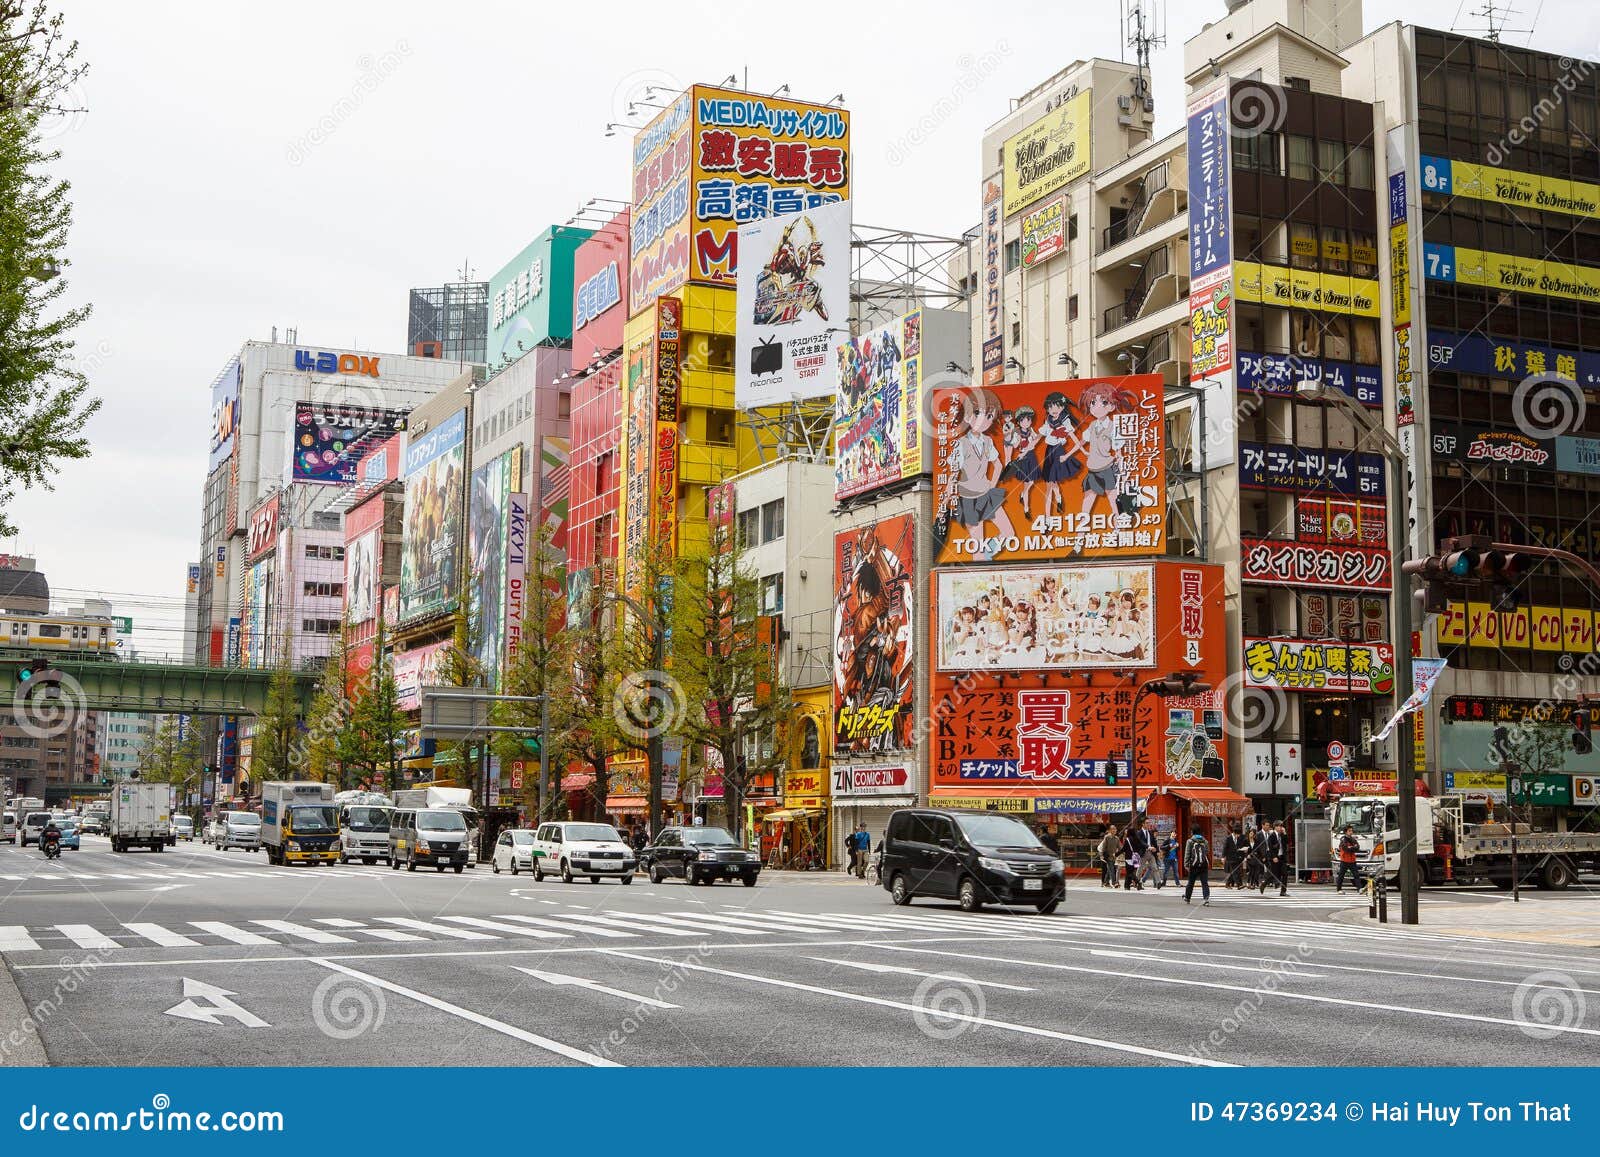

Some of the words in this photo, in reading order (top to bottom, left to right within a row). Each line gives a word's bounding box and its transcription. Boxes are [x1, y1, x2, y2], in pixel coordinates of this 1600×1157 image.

[698, 98, 846, 138] MEDIAリサイクル
[698, 129, 844, 185] 激安販売
[1015, 136, 1048, 172] Yellow
[1018, 142, 1076, 190] Submarine
[1200, 110, 1217, 267] アメニティードリーム
[1424, 164, 1448, 190] 8F
[1495, 182, 1533, 203] Yellow
[1535, 190, 1596, 214] Submarine
[1328, 245, 1341, 256] 7F
[1426, 253, 1451, 278] 7F
[575, 260, 622, 332] SEGA
[1274, 281, 1312, 302] Yellow
[1313, 286, 1373, 310] Submarine
[1499, 269, 1538, 290] Yellow
[1539, 275, 1600, 298] Submarine
[1192, 307, 1228, 338] まんが
[660, 342, 677, 350] DVD
[790, 342, 829, 357] 公式生放送
[1192, 336, 1215, 358] 喫茶
[1430, 345, 1453, 364] 5F
[799, 368, 820, 379] START
[1493, 345, 1578, 381] 秋葉館
[750, 376, 783, 388] niconico
[1357, 387, 1376, 401] 6F
[312, 413, 387, 429] ラブメルシー
[1139, 389, 1161, 480] とある科学の
[1112, 413, 1140, 496] 超電磁砲
[1433, 434, 1457, 454] 5F
[1243, 448, 1347, 479] アメニティードリーム
[1360, 477, 1378, 492] 5F
[511, 501, 525, 555] AKKY
[952, 535, 1020, 556] TOKYO
[1023, 532, 1055, 553] MX
[1055, 528, 1161, 550] 他にて放送開始!
[1300, 523, 1323, 534] Stars
[1246, 545, 1386, 584] メイドカジノ
[508, 578, 522, 621] DUTY
[1180, 569, 1204, 639] 買取
[1440, 604, 1600, 644] アニメDVD・CD・テレ
[1189, 642, 1197, 661] 入口
[1245, 640, 1372, 684] まんが喫茶
[1274, 671, 1327, 688] ゲラゲラ
[837, 704, 900, 740] ドリフターズ
[960, 692, 976, 756] アイドル
[978, 692, 995, 739] アニメ
[996, 691, 1015, 758] 美少女系
[1074, 691, 1093, 758] フィギュア
[1094, 690, 1112, 740] ホビー
[1455, 701, 1484, 718] 買取
[1016, 690, 1073, 781] 買取
[1331, 745, 1341, 756] 40
[834, 766, 853, 793] ZIN
[854, 770, 881, 786] COMIC
[882, 769, 894, 785] ZIN
[961, 761, 1016, 778] チケット
[1255, 773, 1300, 782] ルノアール
